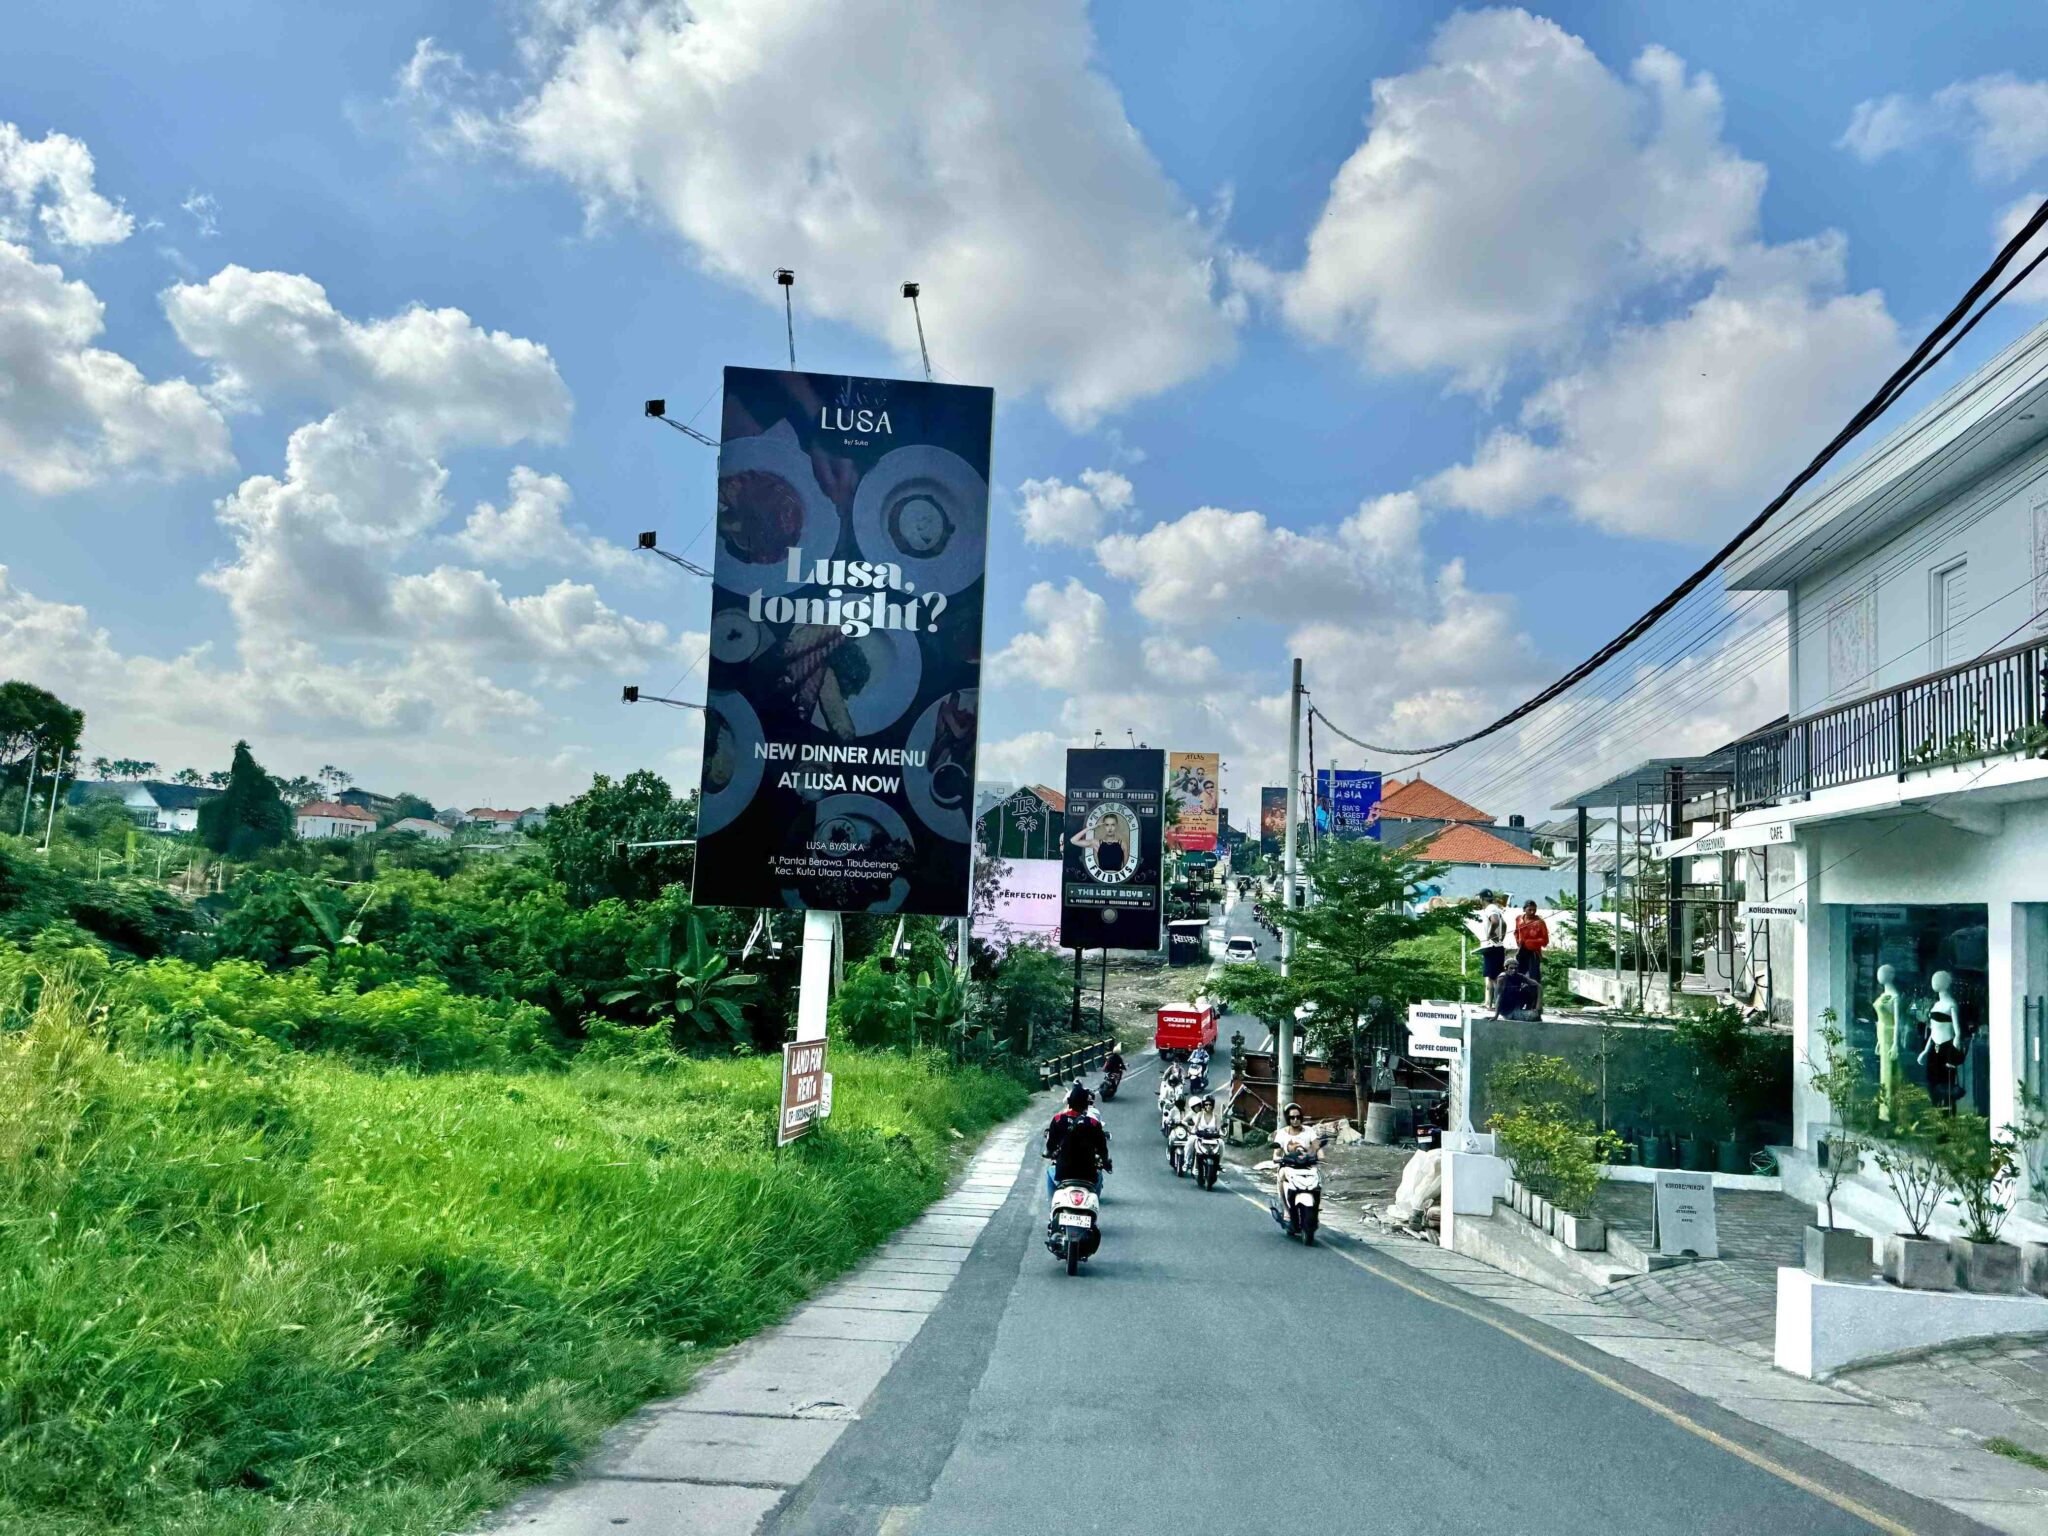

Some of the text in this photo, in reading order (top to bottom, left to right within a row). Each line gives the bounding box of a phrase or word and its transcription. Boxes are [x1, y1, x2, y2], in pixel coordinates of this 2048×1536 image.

[821, 406, 893, 435] LUSA
[784, 546, 915, 595] Lusa,
[747, 588, 948, 638] tonight?
[754, 742, 926, 767] NEW DINNER MENU
[778, 771, 900, 794] AT LUSA NOW
[1072, 791, 1083, 799] THE
[1127, 792, 1155, 800] PRESENTS
[1090, 802, 1135, 823] TINKA
[1769, 825, 1784, 841] CAFE
[805, 841, 865, 852] LUSA BY/SUKA
[779, 856, 807, 866] Pantai
[774, 866, 893, 880] Kec. Kuta Utara Kabupaten
[1089, 865, 1133, 883] FRIDAYS
[1077, 888, 1144, 898] THE LOST BOYS
[1748, 906, 1798, 915] KOROBEYNIKOV
[1416, 1012, 1457, 1020] KOROBEYNIKOV
[1435, 1045, 1458, 1053] CORNER
[791, 1047, 822, 1076] LAND FOR
